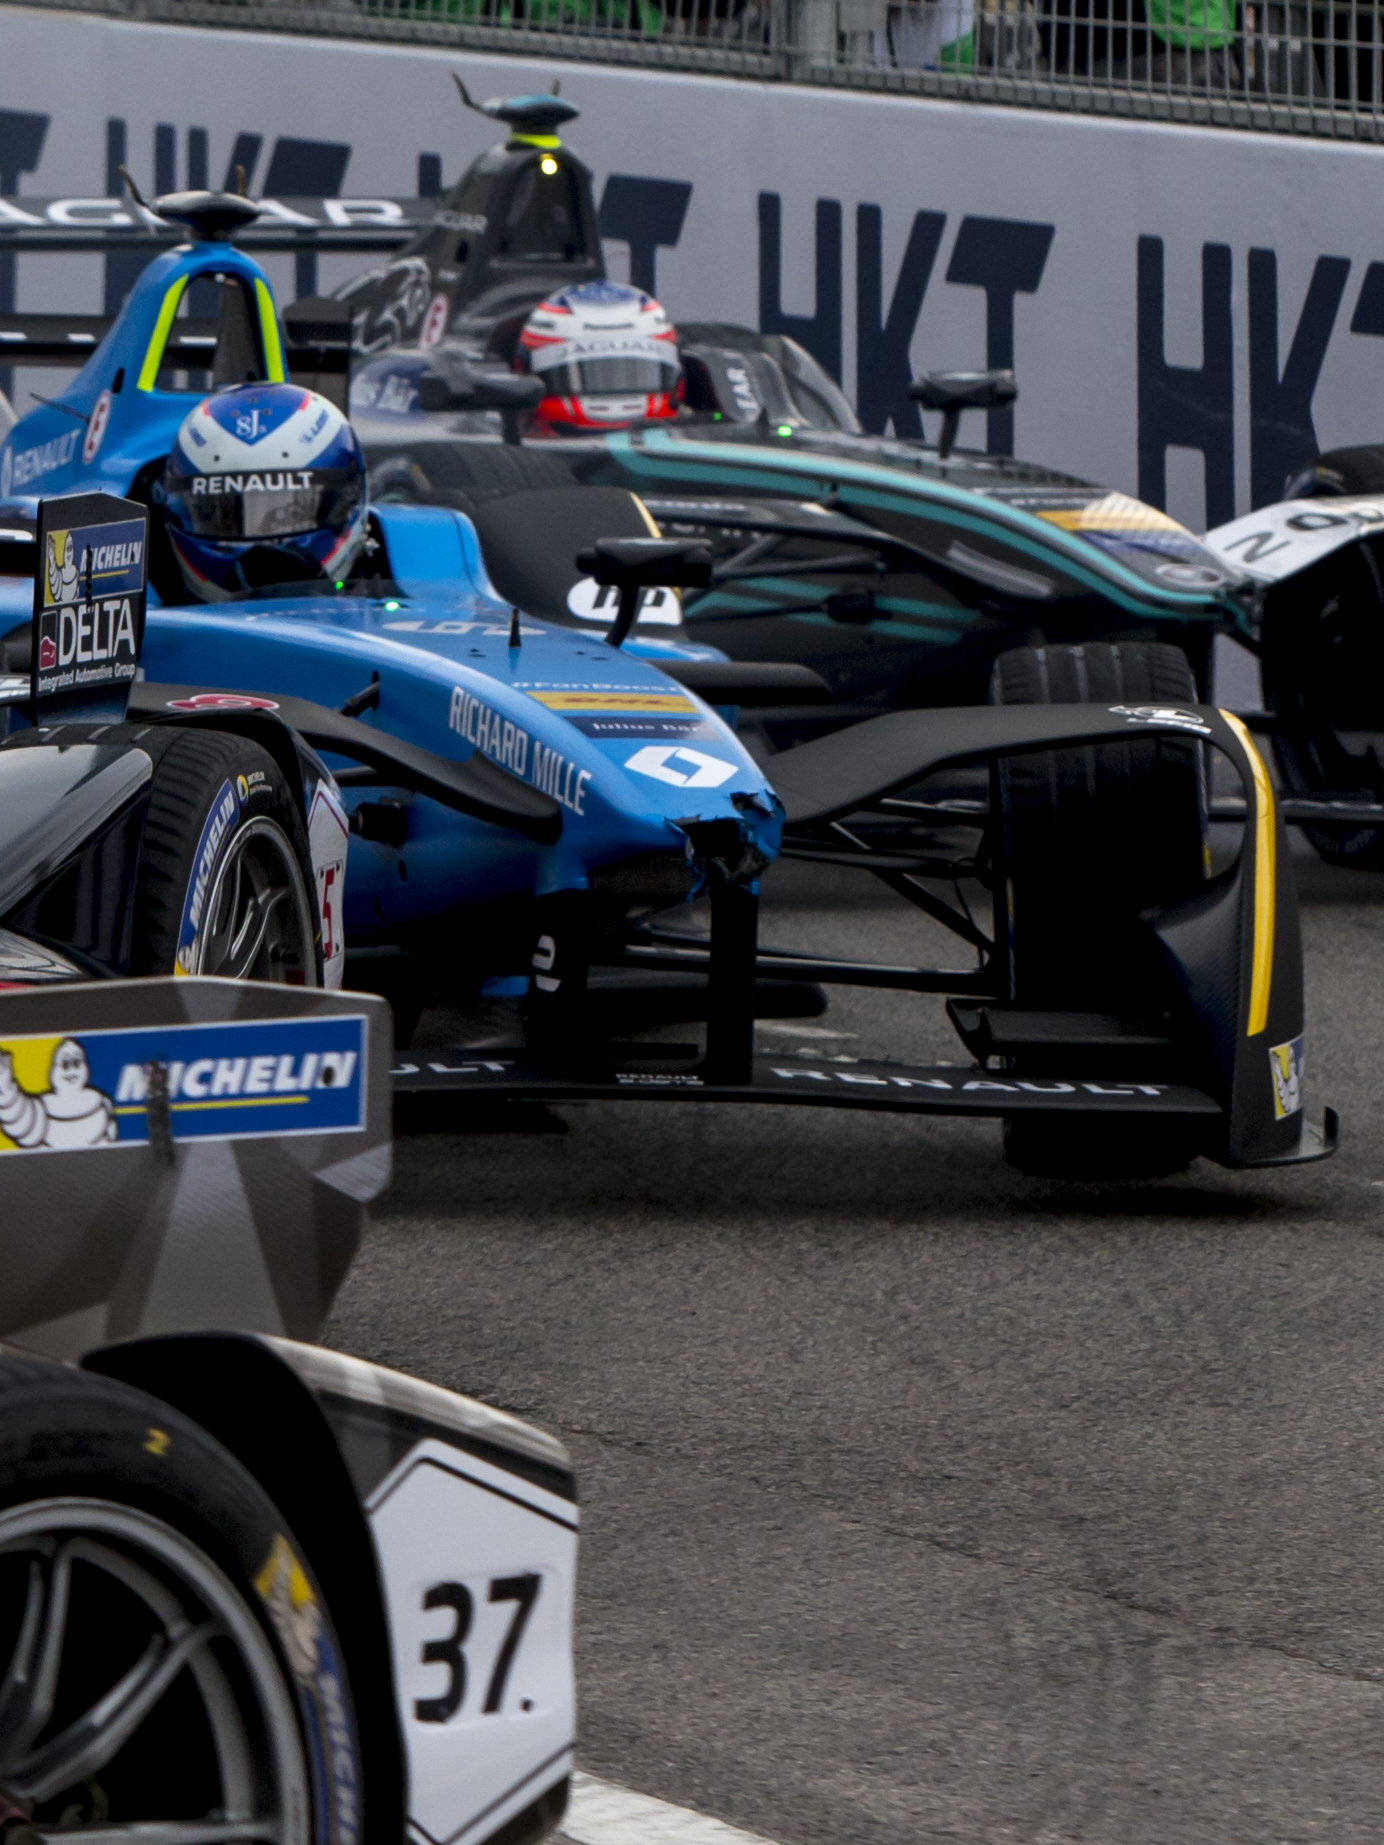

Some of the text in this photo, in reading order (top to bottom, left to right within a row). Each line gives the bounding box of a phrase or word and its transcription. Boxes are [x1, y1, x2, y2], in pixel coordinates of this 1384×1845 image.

[757, 190, 1056, 457] HKT
[1137, 234, 1384, 532] HK
[14, 427, 82, 488] RENAULT
[192, 471, 315, 496] RENAULT
[58, 598, 136, 667] DELTA
[38, 662, 136, 693] Integrated Automotive Group
[449, 685, 593, 816] RICHARD MILLE
[190, 790, 235, 931] MICHELIN
[116, 1050, 357, 1102] MICHELIN
[771, 1066, 1169, 1097] RENAULT
